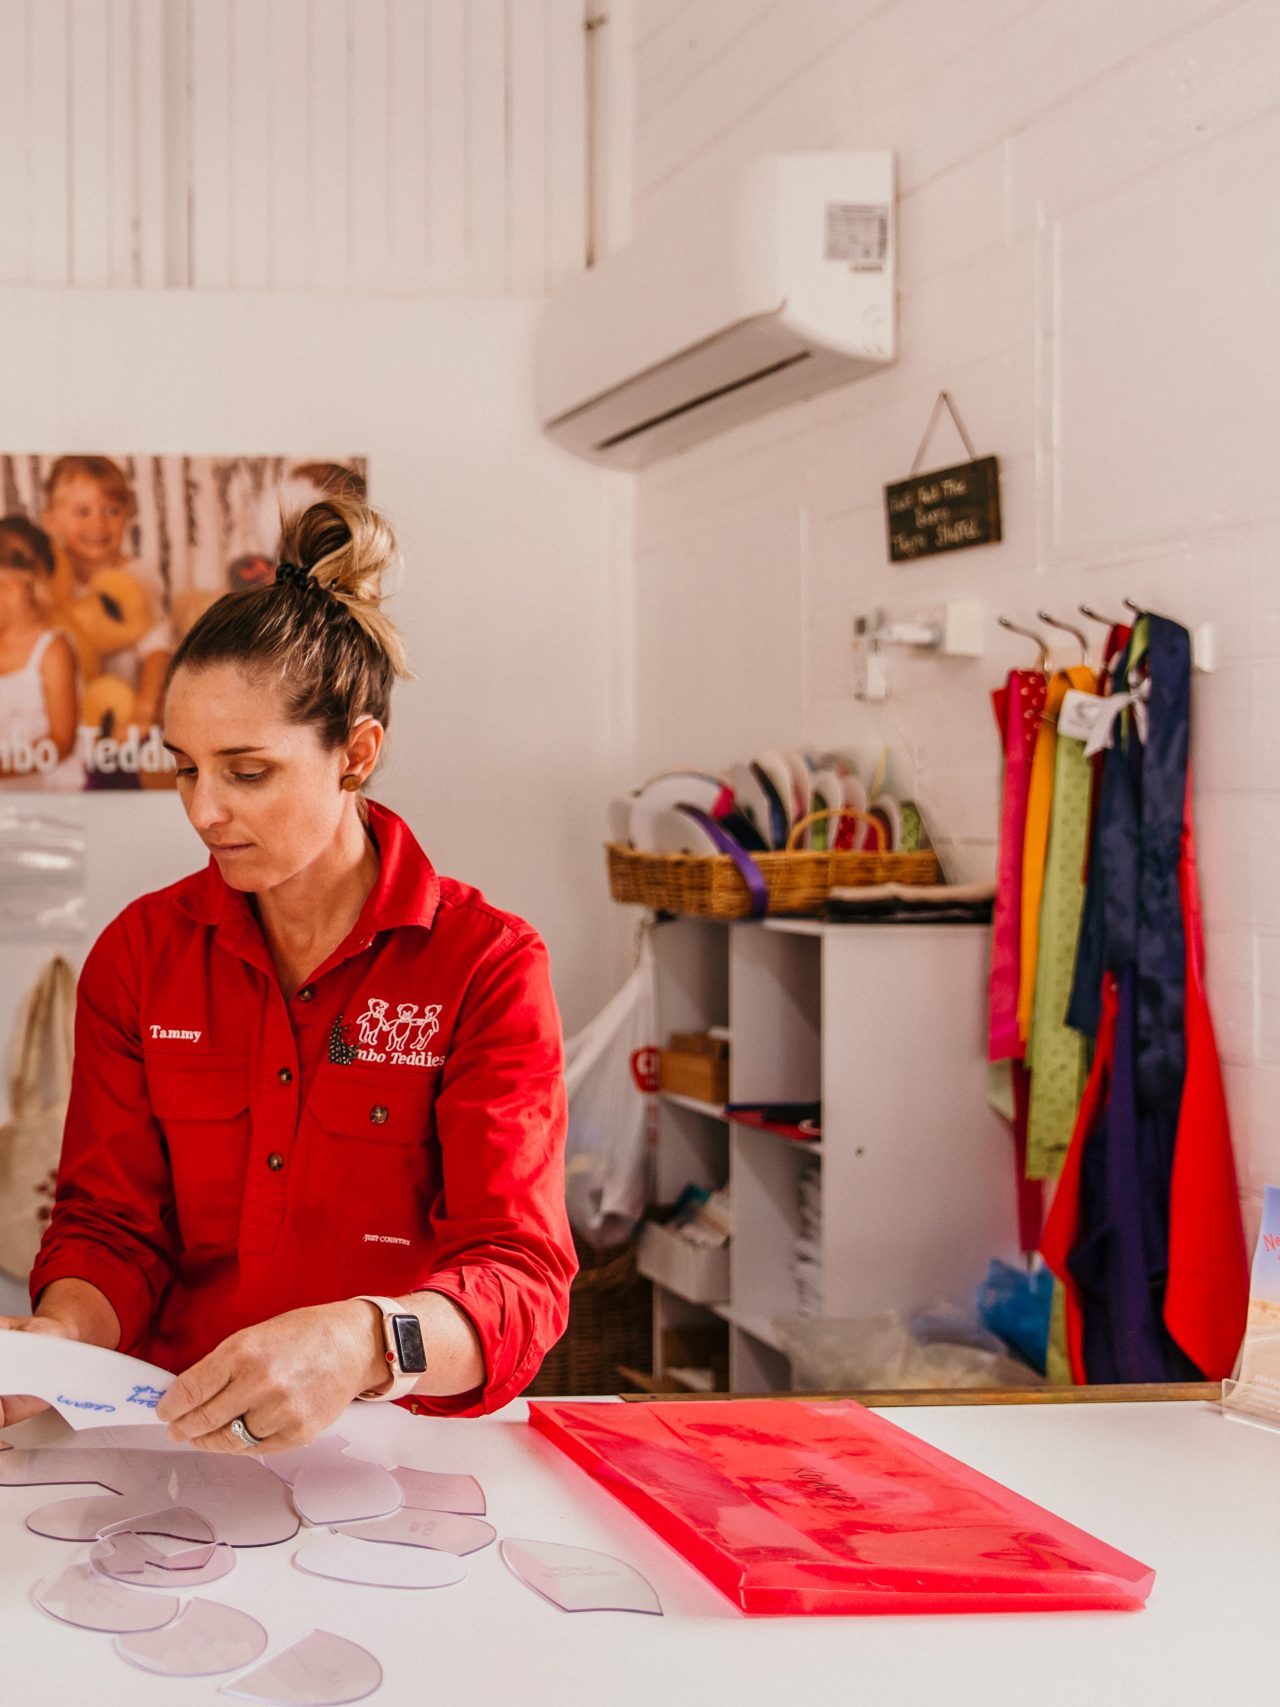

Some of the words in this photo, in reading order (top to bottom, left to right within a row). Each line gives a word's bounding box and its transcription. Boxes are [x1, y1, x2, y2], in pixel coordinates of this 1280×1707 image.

[149, 1025, 202, 1043] Tammy
[355, 1048, 387, 1063] mbo
[389, 1051, 446, 1068] Teddies
